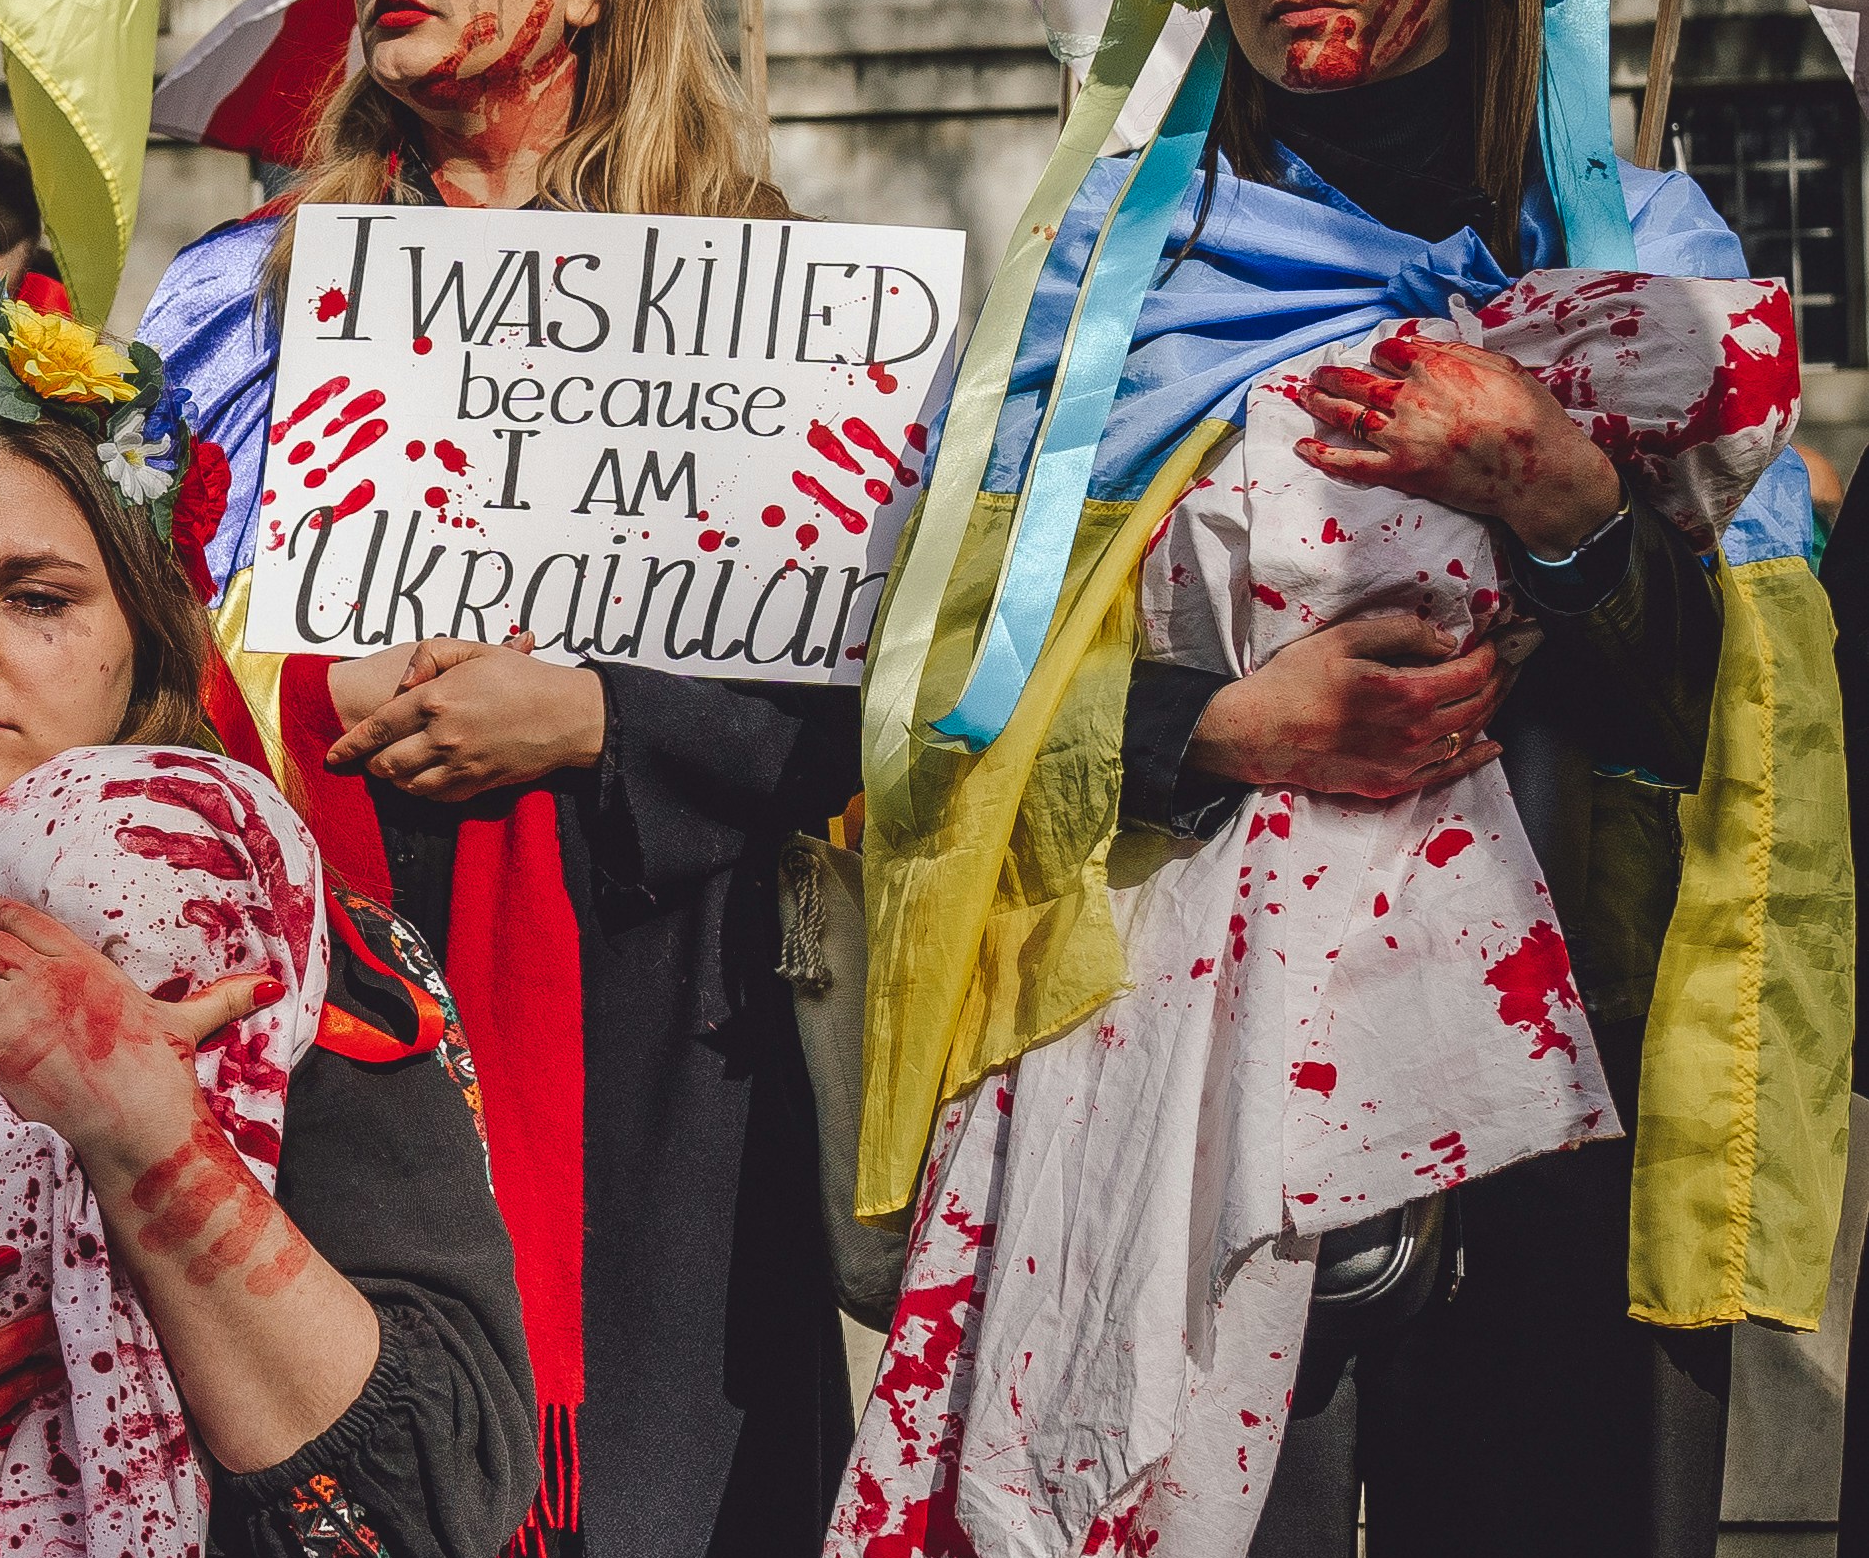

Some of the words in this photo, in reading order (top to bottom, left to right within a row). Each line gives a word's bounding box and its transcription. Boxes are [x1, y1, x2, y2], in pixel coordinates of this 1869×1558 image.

[317, 216, 395, 341] I
[400, 245, 610, 352] WAS
[457, 352, 787, 436] because
[484, 429, 541, 510] I
[572, 447, 701, 520] AM
